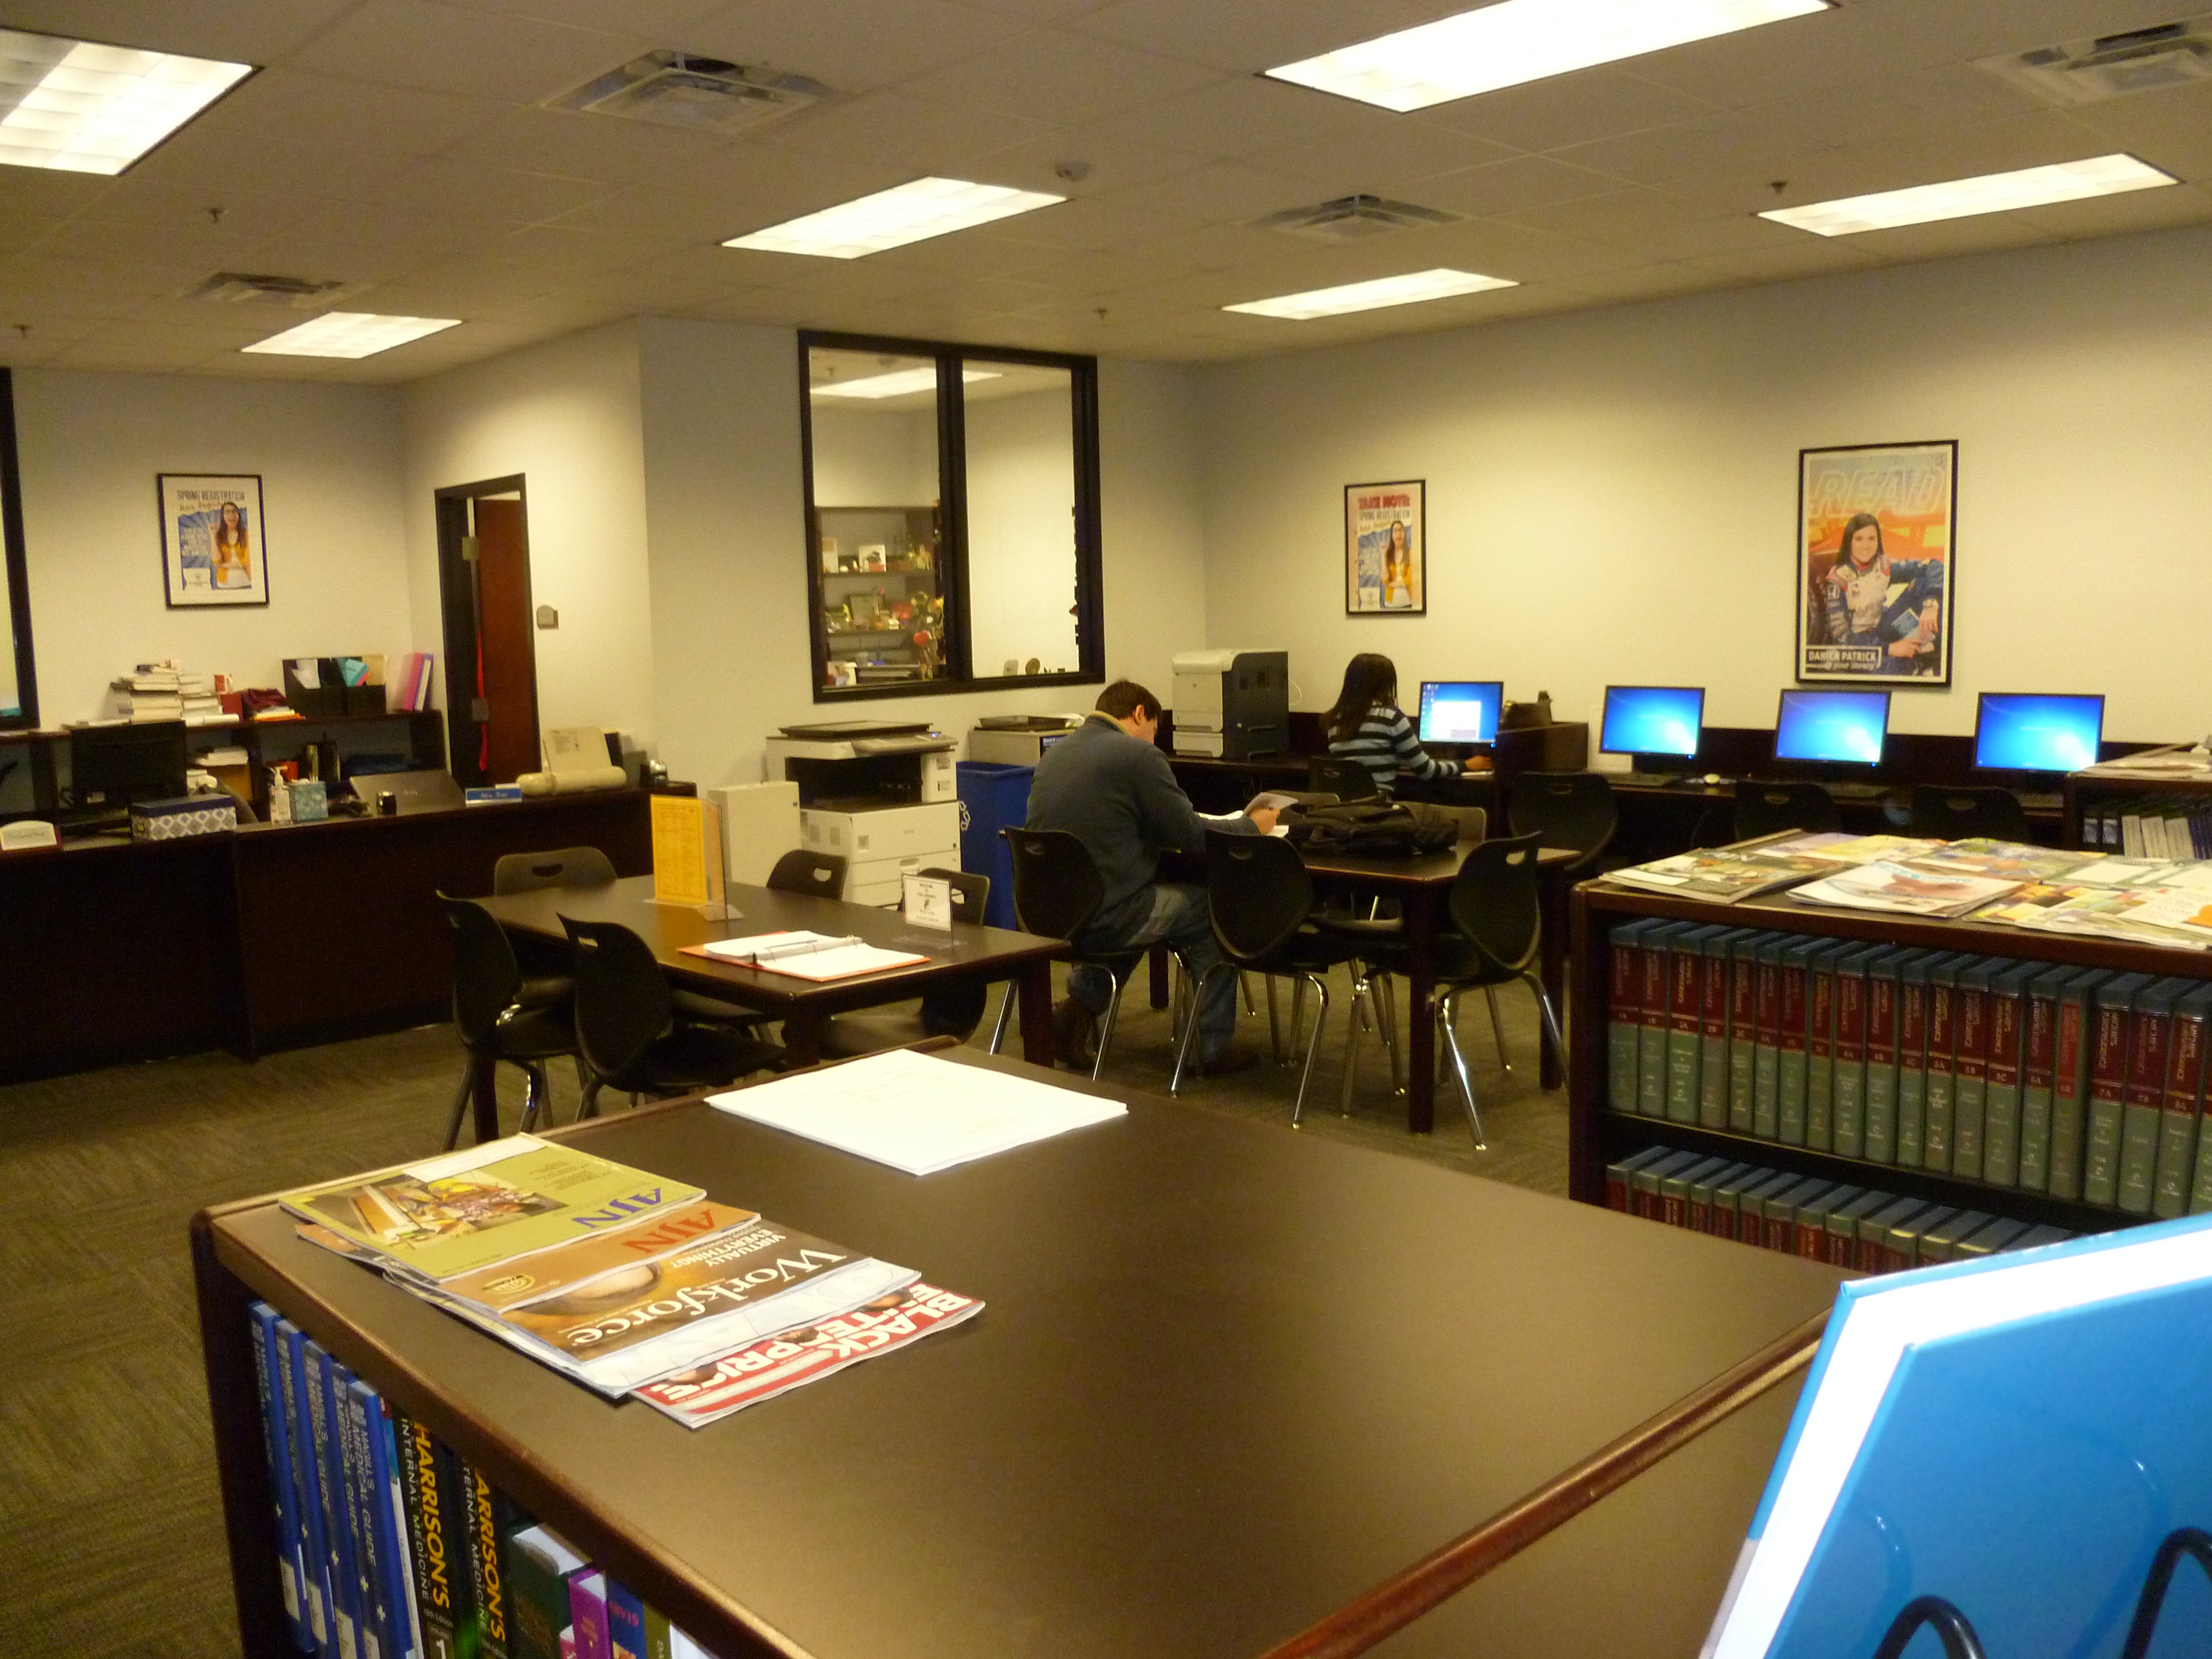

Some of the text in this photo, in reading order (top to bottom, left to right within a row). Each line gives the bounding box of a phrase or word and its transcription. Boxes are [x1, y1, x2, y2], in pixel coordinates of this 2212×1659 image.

[178, 490, 245, 501] SPRING REGISTRATION
[1842, 651, 1877, 662] PATRICK
[572, 1188, 663, 1228] AJN
[622, 1209, 716, 1254] AJN
[671, 1228, 774, 1269] EVERYTHING?
[707, 1233, 787, 1268] VIRTUALLY
[567, 1248, 848, 1347] Workforce
[818, 1292, 973, 1358] BLACK
[362, 1508, 376, 1567] GUIDE
[401, 1417, 430, 1602] INTERNAL MEDICINE
[413, 1421, 450, 1609] HARRISON'S
[474, 1466, 506, 1642] ARRISON'S
[471, 1542, 490, 1632] MEDICINE
